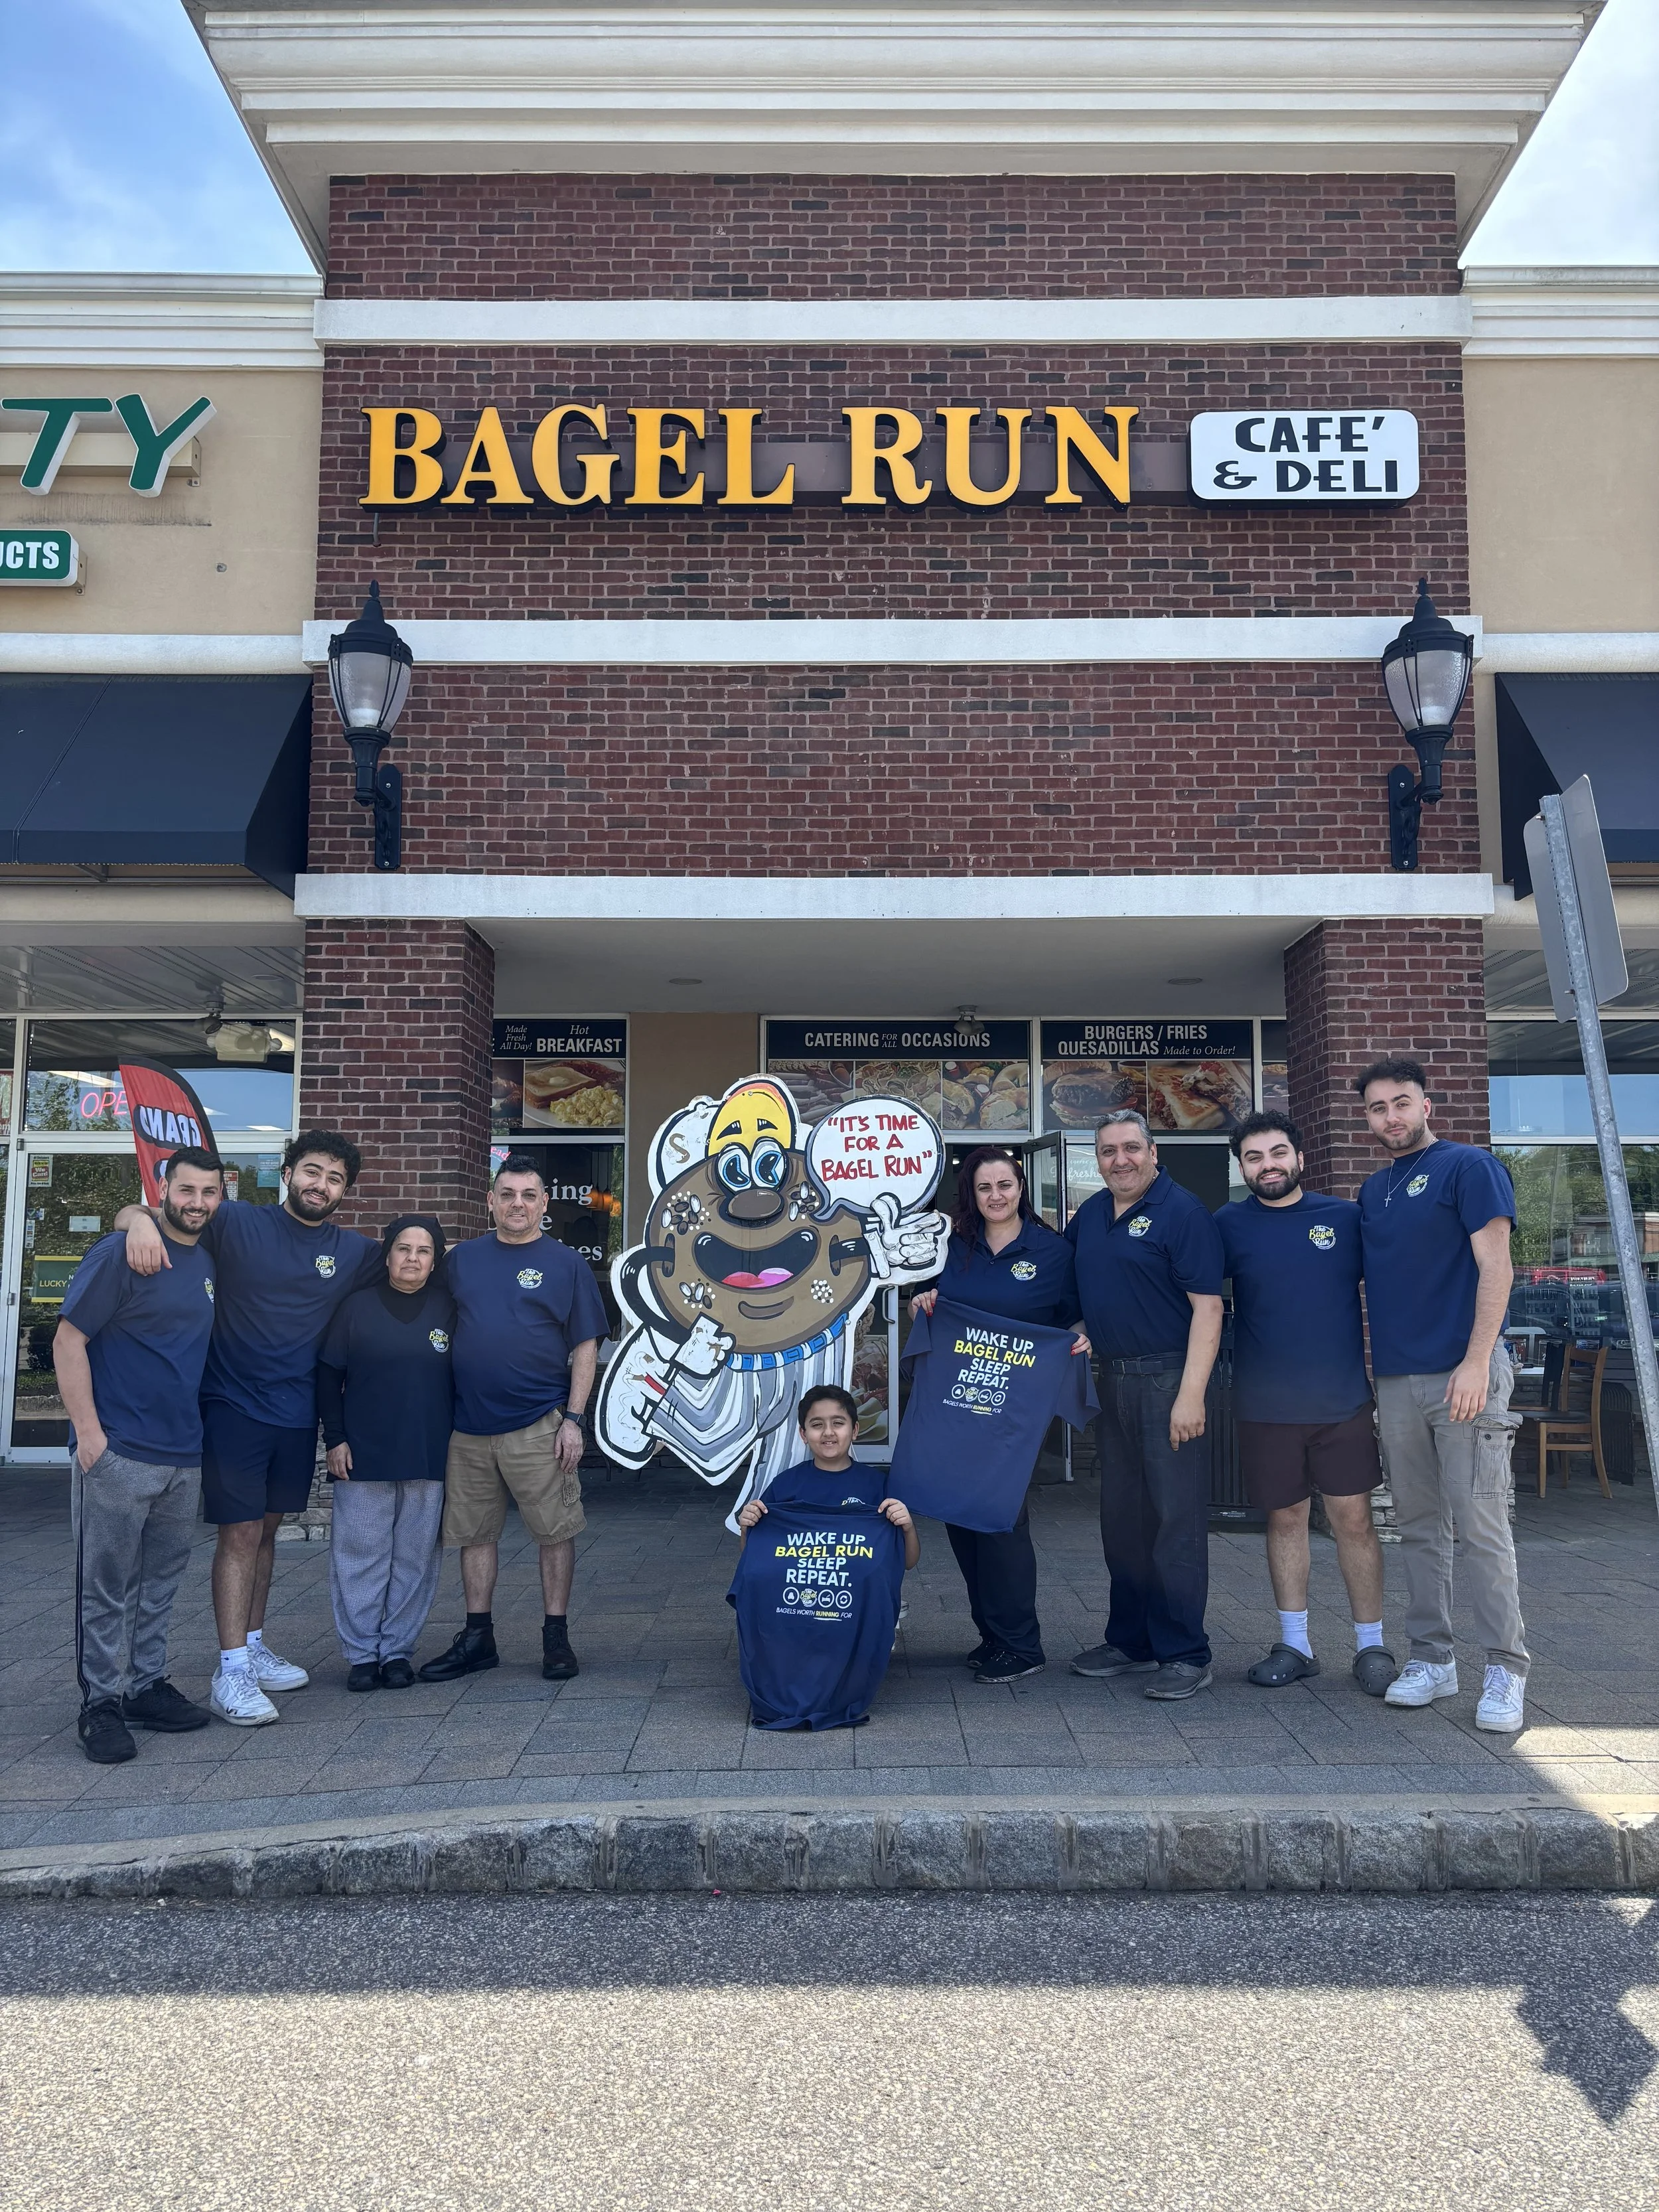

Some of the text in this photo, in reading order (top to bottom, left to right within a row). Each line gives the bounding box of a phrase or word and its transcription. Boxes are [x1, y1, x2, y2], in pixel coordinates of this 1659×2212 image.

[359, 403, 1139, 509] BAGEL RUN
[1213, 459, 1398, 493] & DELI
[505, 1025, 528, 1033] Made
[569, 1025, 589, 1035] Hot
[1084, 1025, 1208, 1041] BURGERS / FRIES
[506, 1033, 526, 1042] Fresh
[804, 1032, 879, 1047] CATERING
[901, 1032, 991, 1047] OCCASIONS
[500, 1042, 512, 1051] All
[514, 1042, 532, 1052] Day!
[536, 1038, 622, 1053] BREAKFAST
[1058, 1041, 1236, 1055] QUESADILLAS Made to Order!
[80, 1090, 129, 1119] OPE
[875, 1114, 920, 1131] TIME
[844, 1134, 904, 1153] FOR A
[821, 1159, 879, 1182] BAGEL
[544, 1178, 593, 1206] ing
[1309, 1228, 1335, 1240] Bagel
[1315, 1238, 1331, 1246] Run
[516, 1270, 543, 1281] Bagel
[1011, 1264, 1037, 1274] Bagel
[966, 1327, 1034, 1353] WAKE UP
[954, 1339, 1036, 1368] BAGEL RUN
[970, 1357, 1011, 1375] SLEEP
[958, 1368, 1009, 1390] REPEAT.
[942, 1398, 960, 1407] BAGELS
[787, 1532, 866, 1546] WAKE UP
[774, 1545, 873, 1559] BAGEL RUN
[797, 1557, 847, 1570] SLEEP
[786, 1568, 852, 1587] REPEAT.
